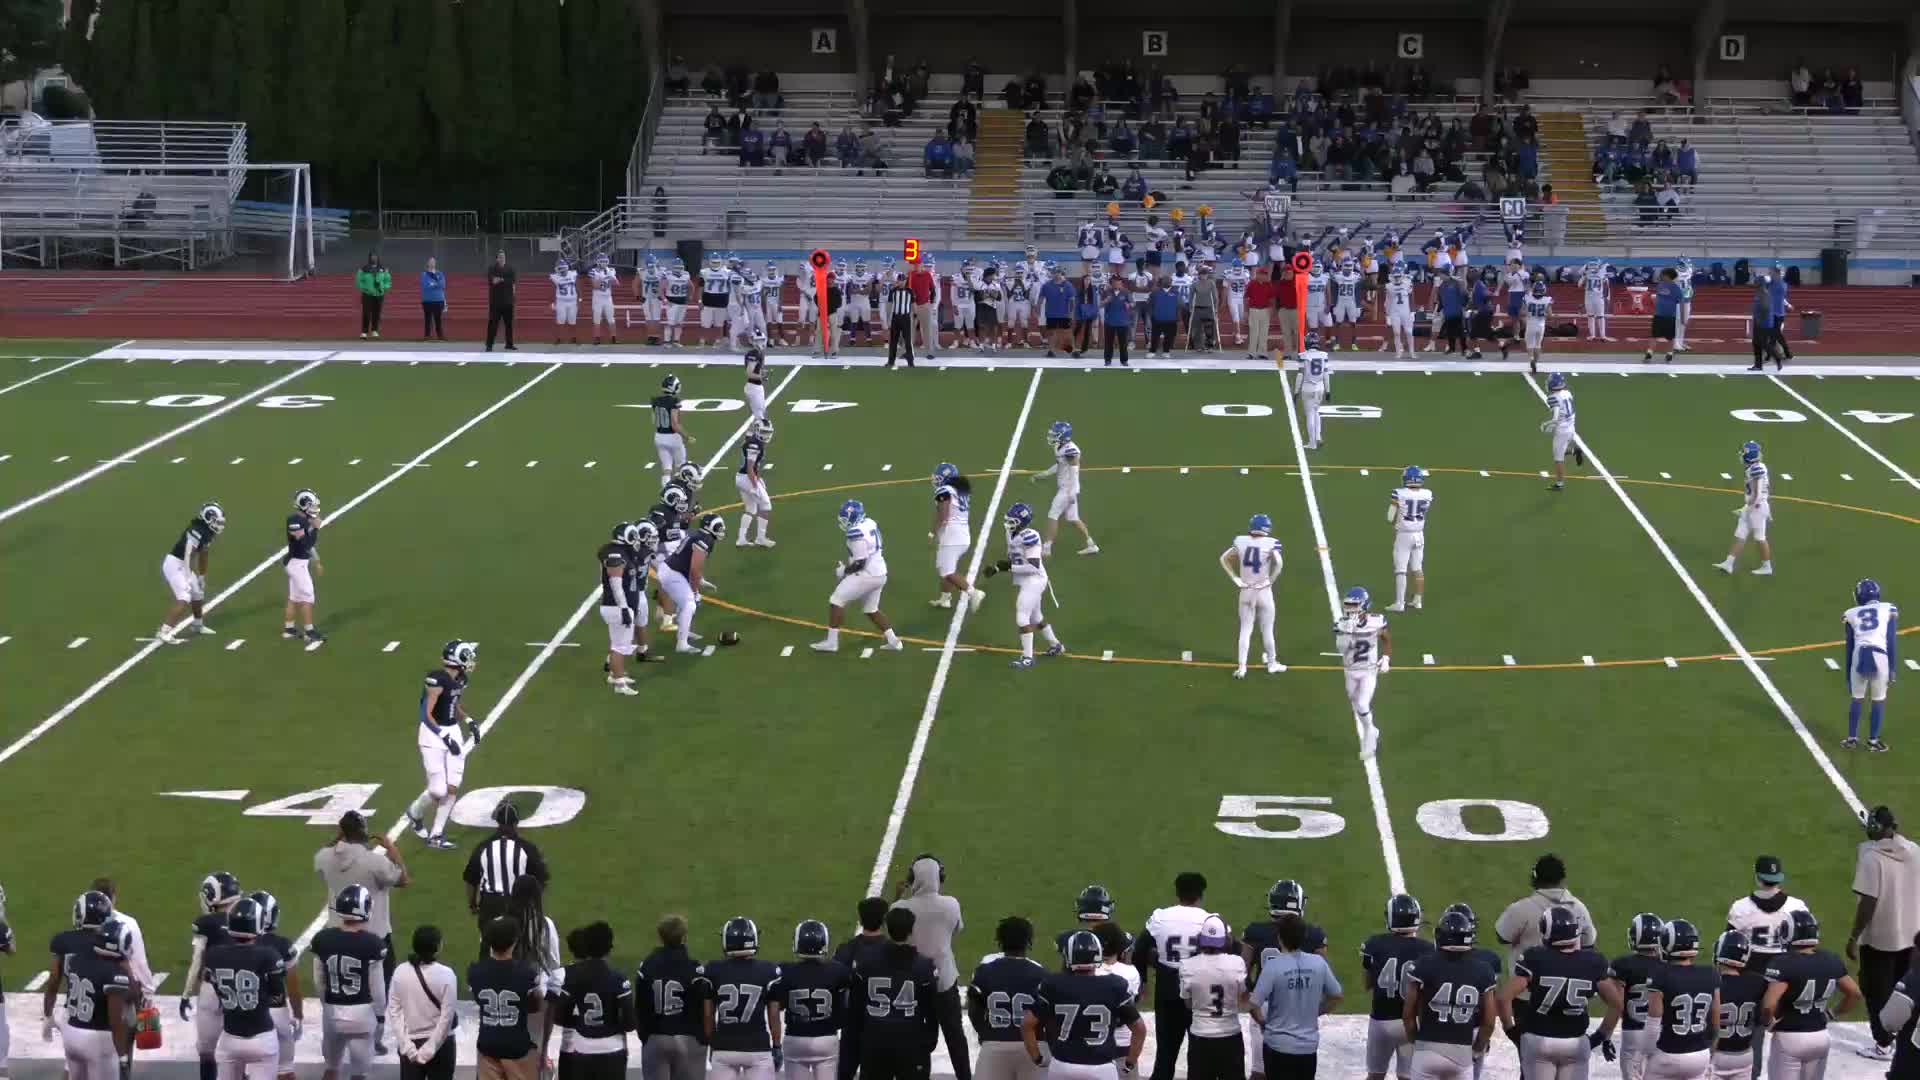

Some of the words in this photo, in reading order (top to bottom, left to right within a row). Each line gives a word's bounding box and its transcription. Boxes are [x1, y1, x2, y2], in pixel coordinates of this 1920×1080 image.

[816, 31, 832, 49] A
[1148, 34, 1162, 52] B
[1404, 36, 1417, 55] C
[1725, 38, 1740, 57] D
[905, 239, 918, 260] 3
[1243, 546, 1262, 574] 4
[1857, 607, 1879, 631] 3
[215, 968, 260, 1011] 58
[326, 954, 362, 995] 15
[478, 988, 520, 1026] 36
[583, 992, 604, 1025] 2
[652, 979, 685, 1015] 16
[717, 984, 763, 1025] 27
[788, 988, 833, 1021] 53
[866, 977, 918, 1017] 54
[1210, 984, 1225, 1016] 3
[1428, 982, 1480, 1024] 48
[1539, 976, 1592, 1016] 75
[1054, 1004, 1112, 1046] 73
[1671, 992, 1713, 1036] 33
